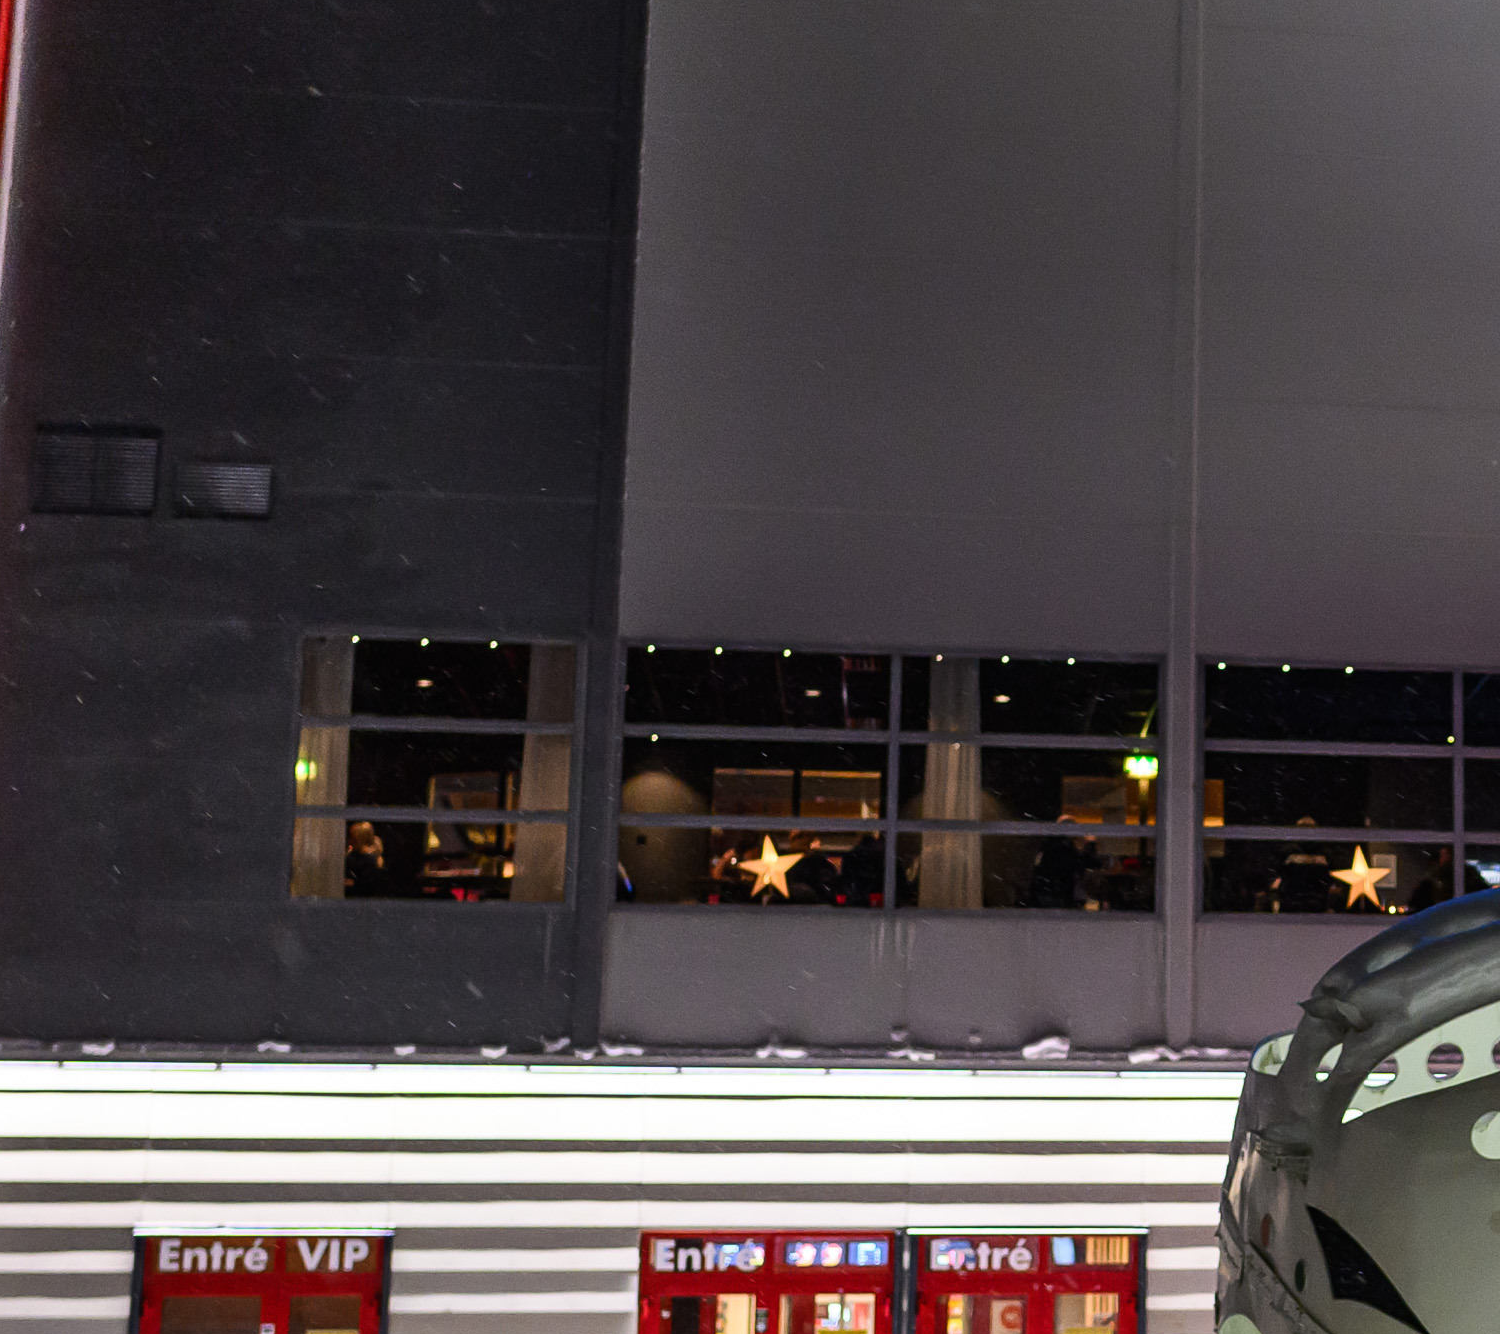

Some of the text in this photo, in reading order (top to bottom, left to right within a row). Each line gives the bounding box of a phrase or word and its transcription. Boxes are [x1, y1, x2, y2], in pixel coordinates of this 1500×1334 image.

[158, 1238, 370, 1273] Entré VIP
[654, 1237, 762, 1272] Entré
[930, 1238, 1033, 1271] Entré
